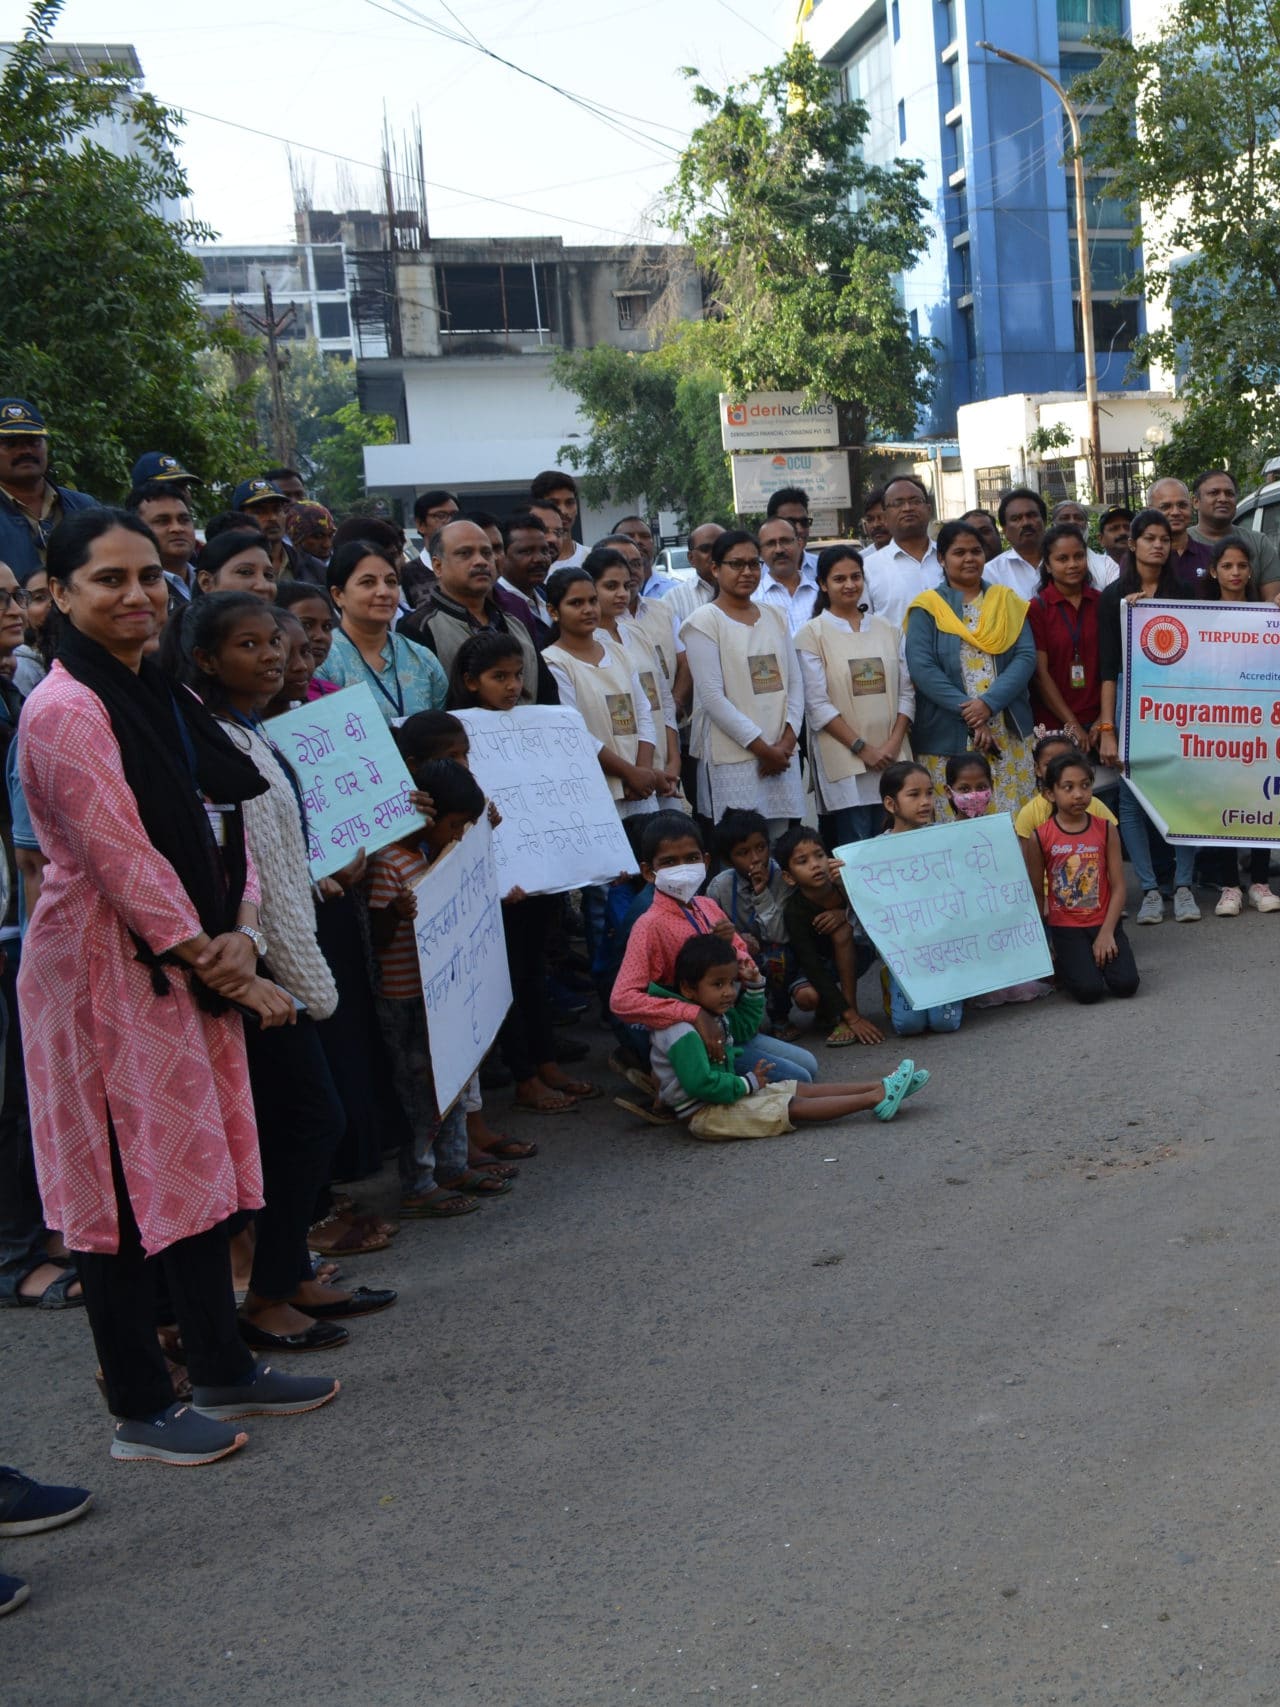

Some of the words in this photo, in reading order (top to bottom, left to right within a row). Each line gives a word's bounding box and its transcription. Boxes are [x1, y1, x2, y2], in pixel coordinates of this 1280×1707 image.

[787, 455, 812, 470] OCW
[1198, 630, 1260, 644] TIRPUDE
[1139, 696, 1263, 727] Programme
[345, 712, 367, 742] की
[1180, 733, 1269, 765] Through
[335, 771, 364, 796] घर
[331, 814, 371, 848] साफ
[373, 780, 416, 829] सफाई
[1221, 808, 1273, 827] (Field
[964, 831, 999, 874] को
